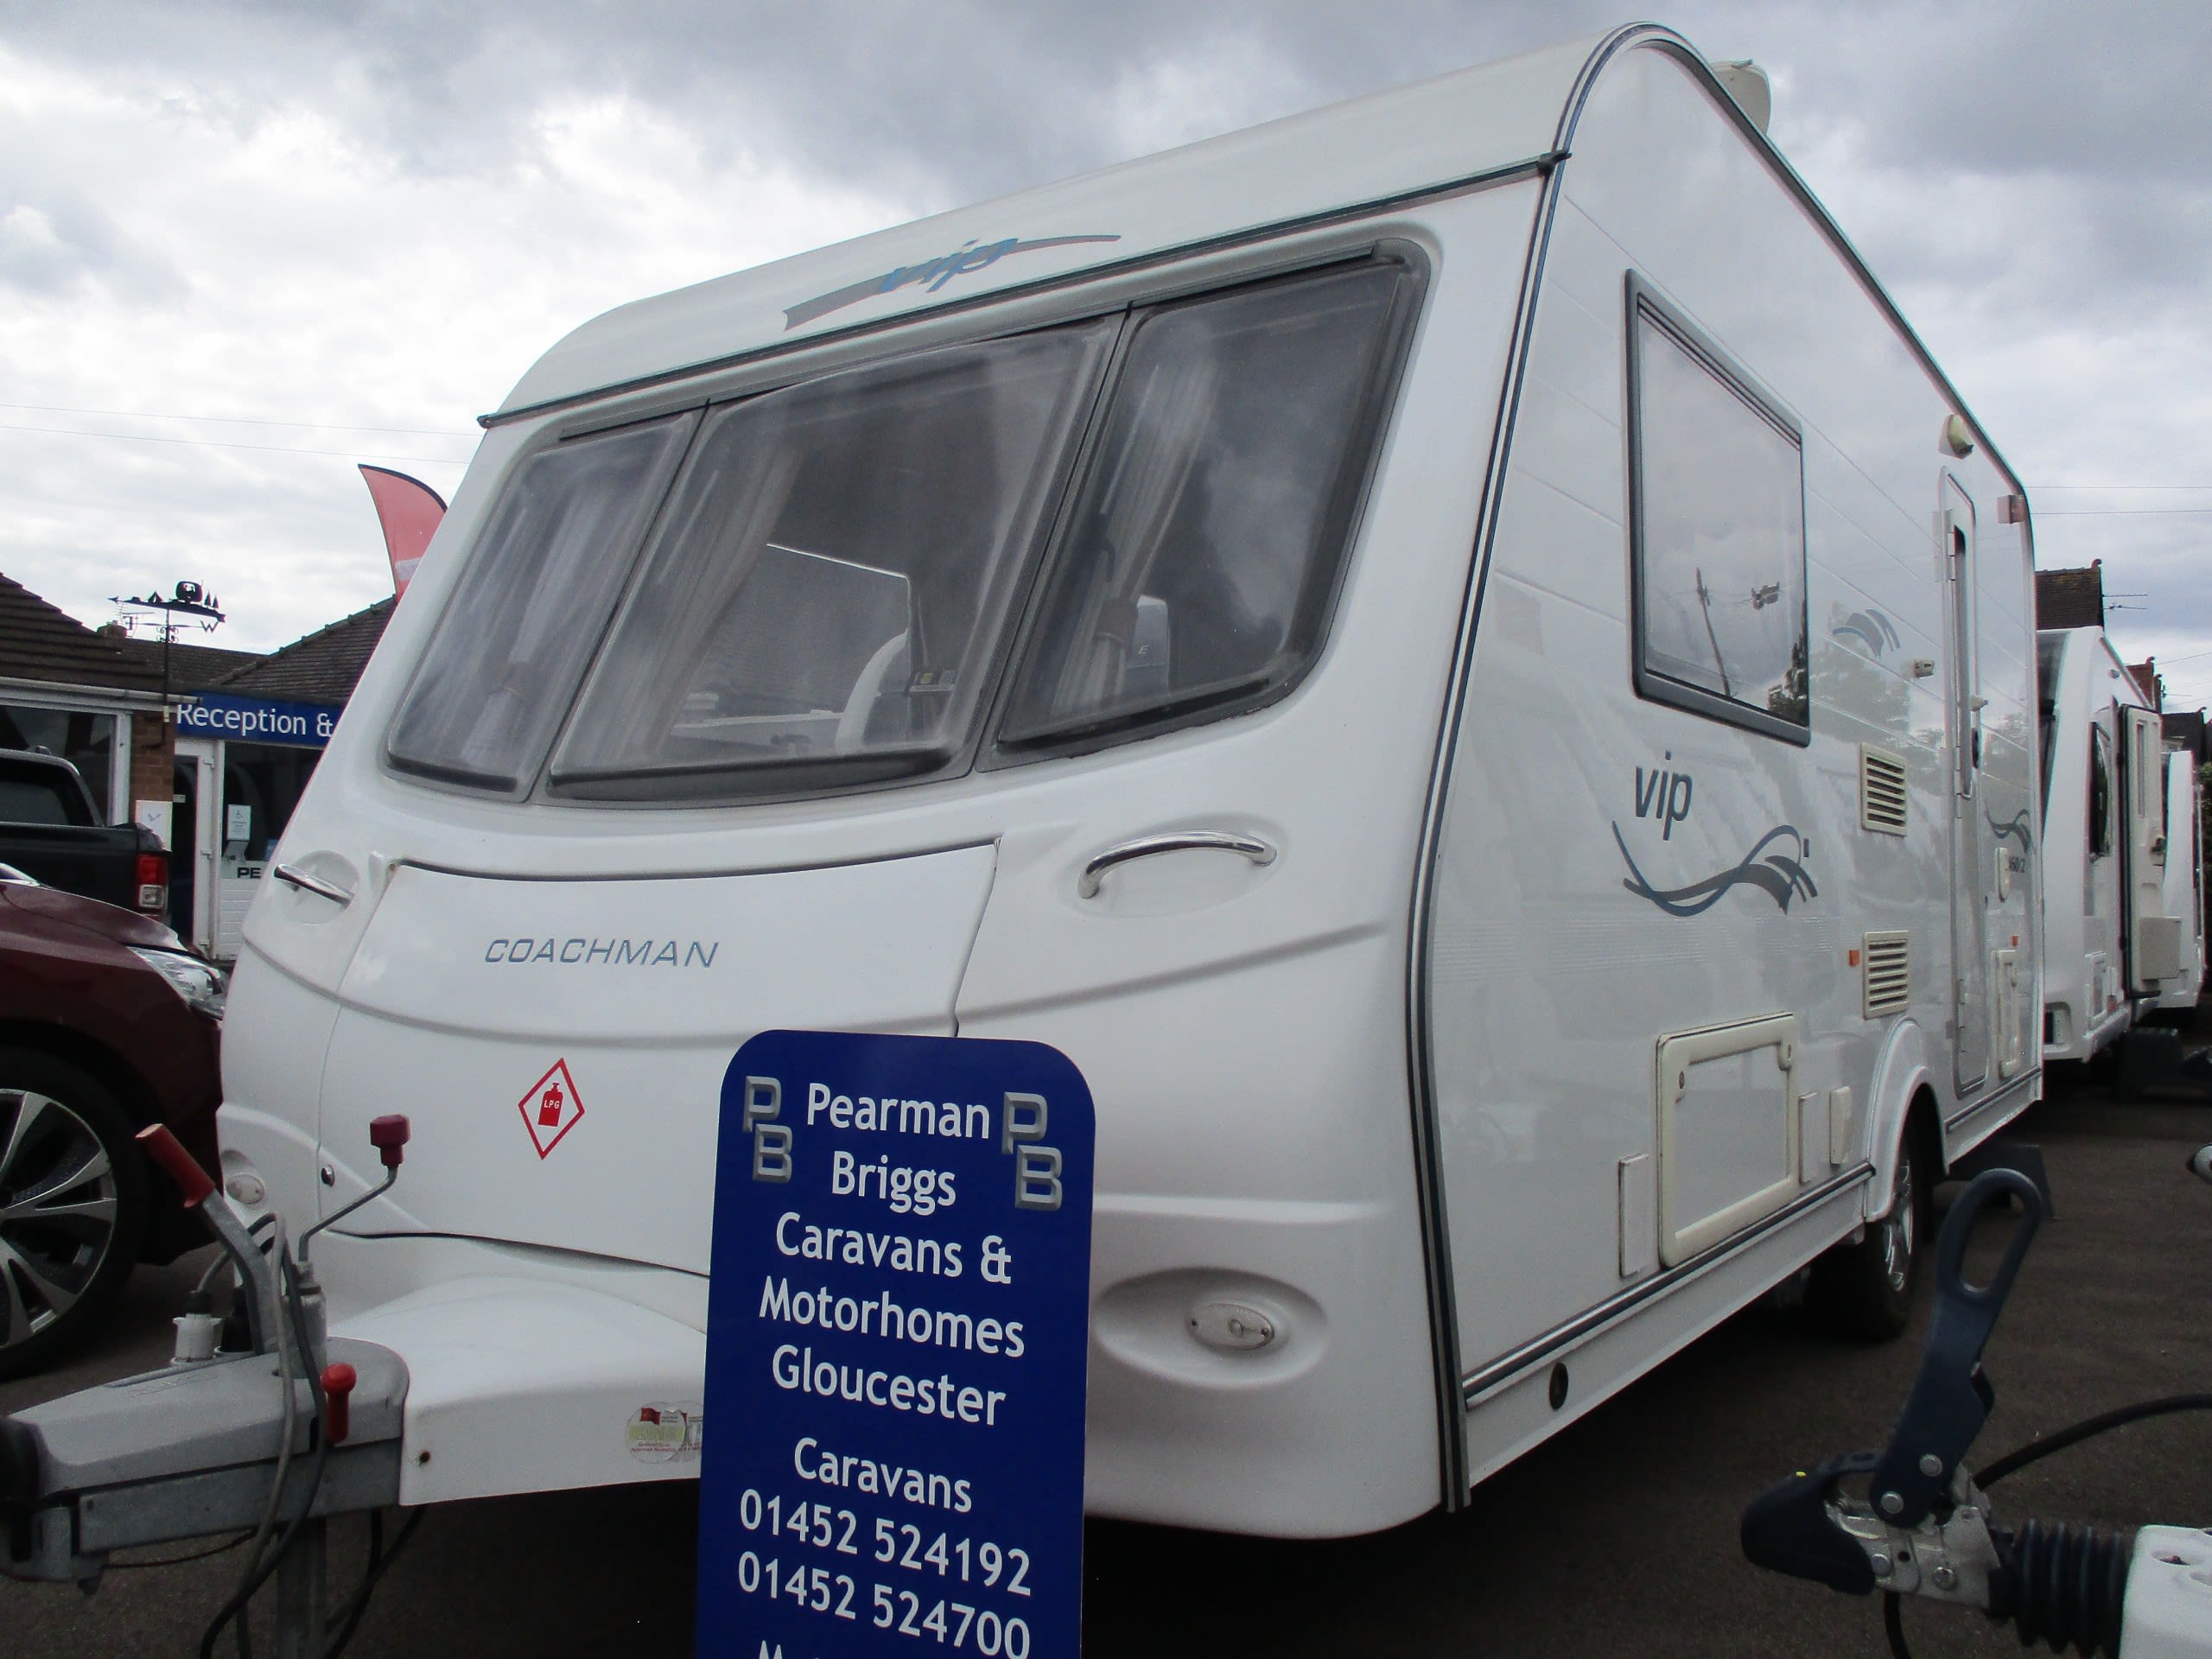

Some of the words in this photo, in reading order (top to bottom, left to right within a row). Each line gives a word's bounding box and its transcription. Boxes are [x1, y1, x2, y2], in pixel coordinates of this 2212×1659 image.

[176, 703, 306, 736] Reception
[316, 712, 334, 737] &
[1633, 749, 1693, 841] vip
[484, 938, 719, 968] COACHMAN
[543, 1099, 561, 1109] LPG
[806, 1082, 990, 1140] Pearman
[831, 1150, 957, 1217] Briggs
[776, 1211, 963, 1278] Caravans
[980, 1235, 1012, 1285] &
[759, 1275, 1025, 1358] Motorhomes
[772, 1344, 1007, 1426] Gloucester
[794, 1437, 972, 1513] Caravans
[740, 1489, 858, 1555] 01452
[874, 1517, 1031, 1597] 524192
[738, 1551, 856, 1620] 01452
[873, 1583, 1030, 1659] 524700
